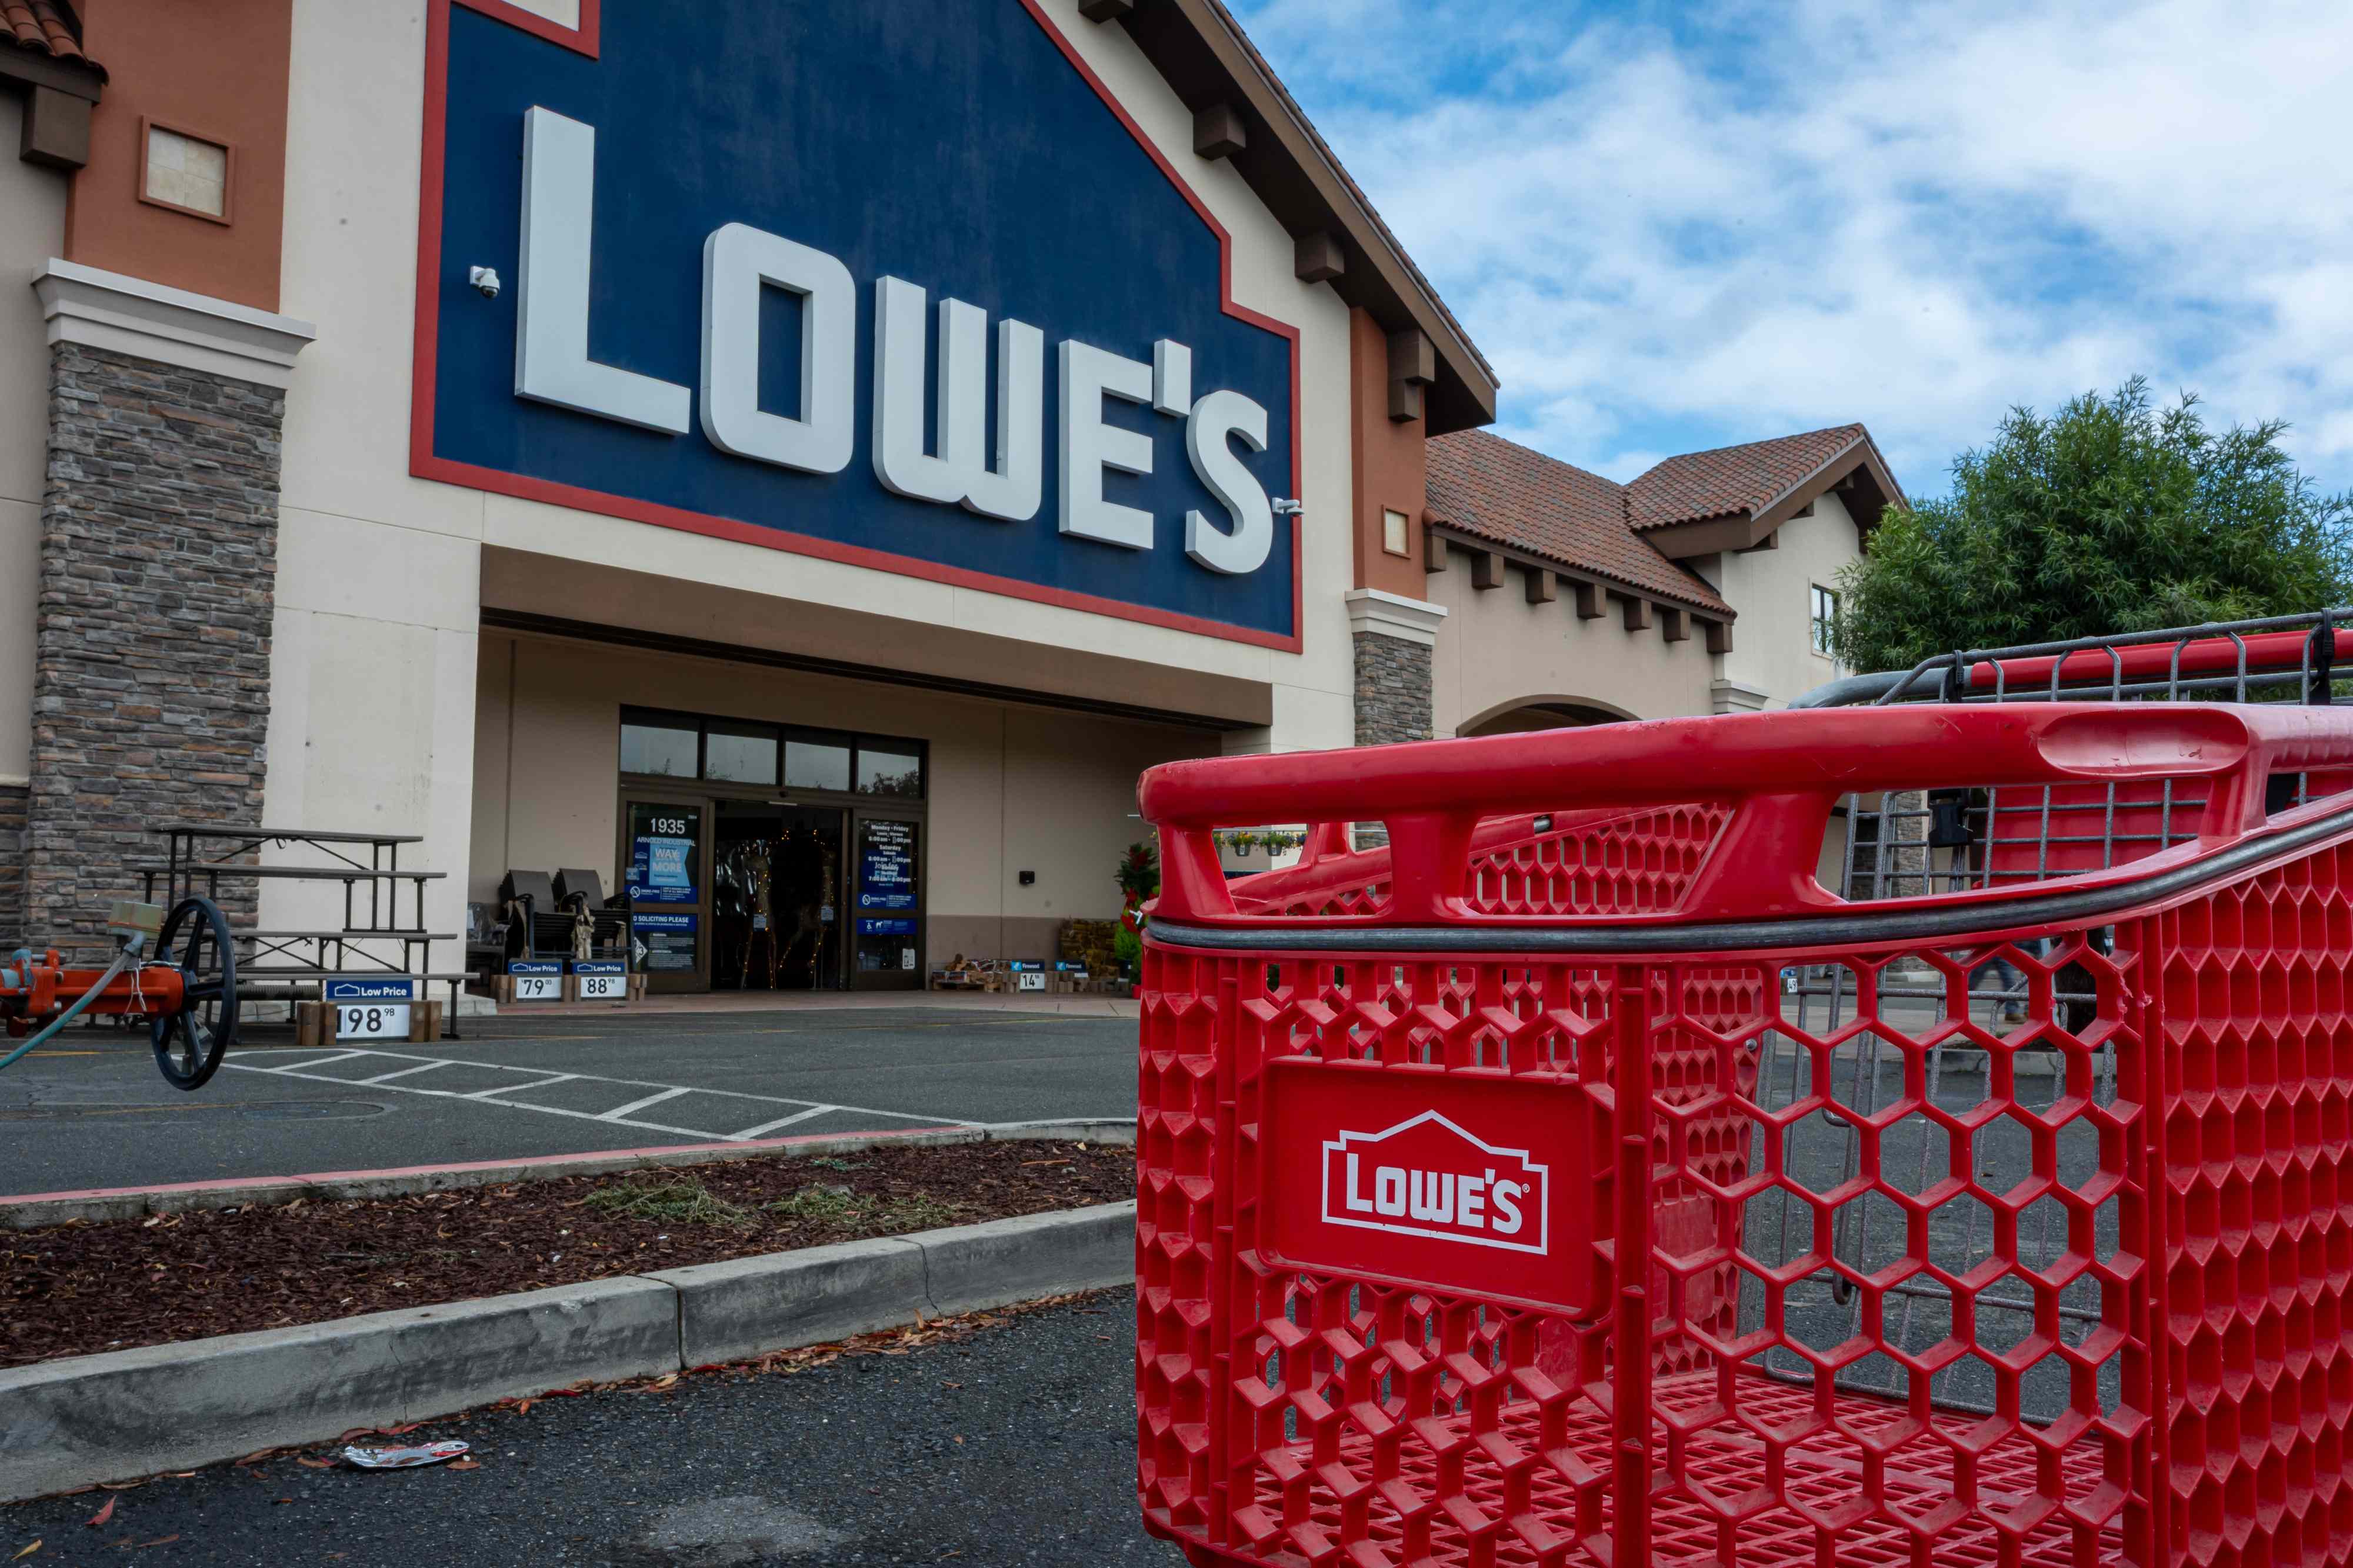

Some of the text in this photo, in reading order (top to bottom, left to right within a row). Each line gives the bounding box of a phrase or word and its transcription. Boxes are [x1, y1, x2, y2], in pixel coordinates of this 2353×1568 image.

[515, 105, 1272, 574] LOWE'S
[651, 818, 685, 834] 1935
[663, 838, 695, 846] INDUSTRIAL
[655, 849, 678, 858] WAY
[652, 862, 682, 872] MORE
[639, 946, 644, 955] 3
[361, 987, 407, 996] Low Price
[1347, 1153, 1522, 1234] LOWE'S
